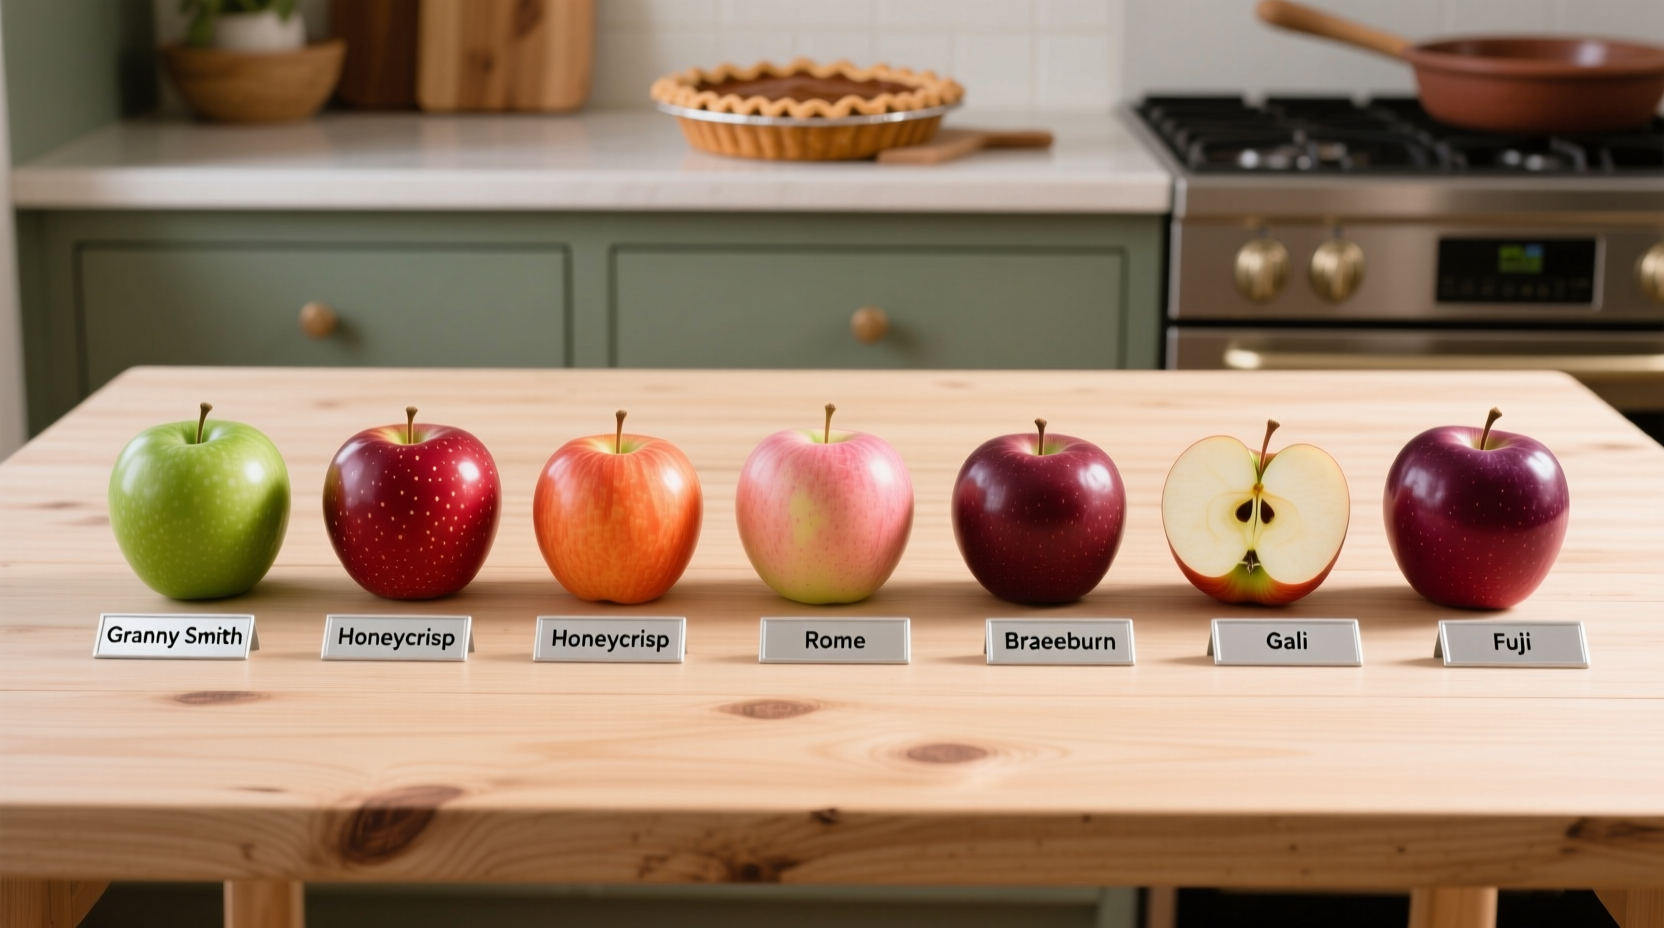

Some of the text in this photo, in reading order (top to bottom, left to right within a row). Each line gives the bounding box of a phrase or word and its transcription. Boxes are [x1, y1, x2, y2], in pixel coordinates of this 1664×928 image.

[107, 625, 243, 649] Granny Smith
[338, 627, 456, 651] Honeycrisp
[551, 628, 670, 653] Honeycrisp
[805, 631, 866, 650] Rome
[1004, 631, 1116, 650] Braeeburn
[1266, 631, 1308, 650] Gali
[1493, 631, 1532, 656] Fuji
